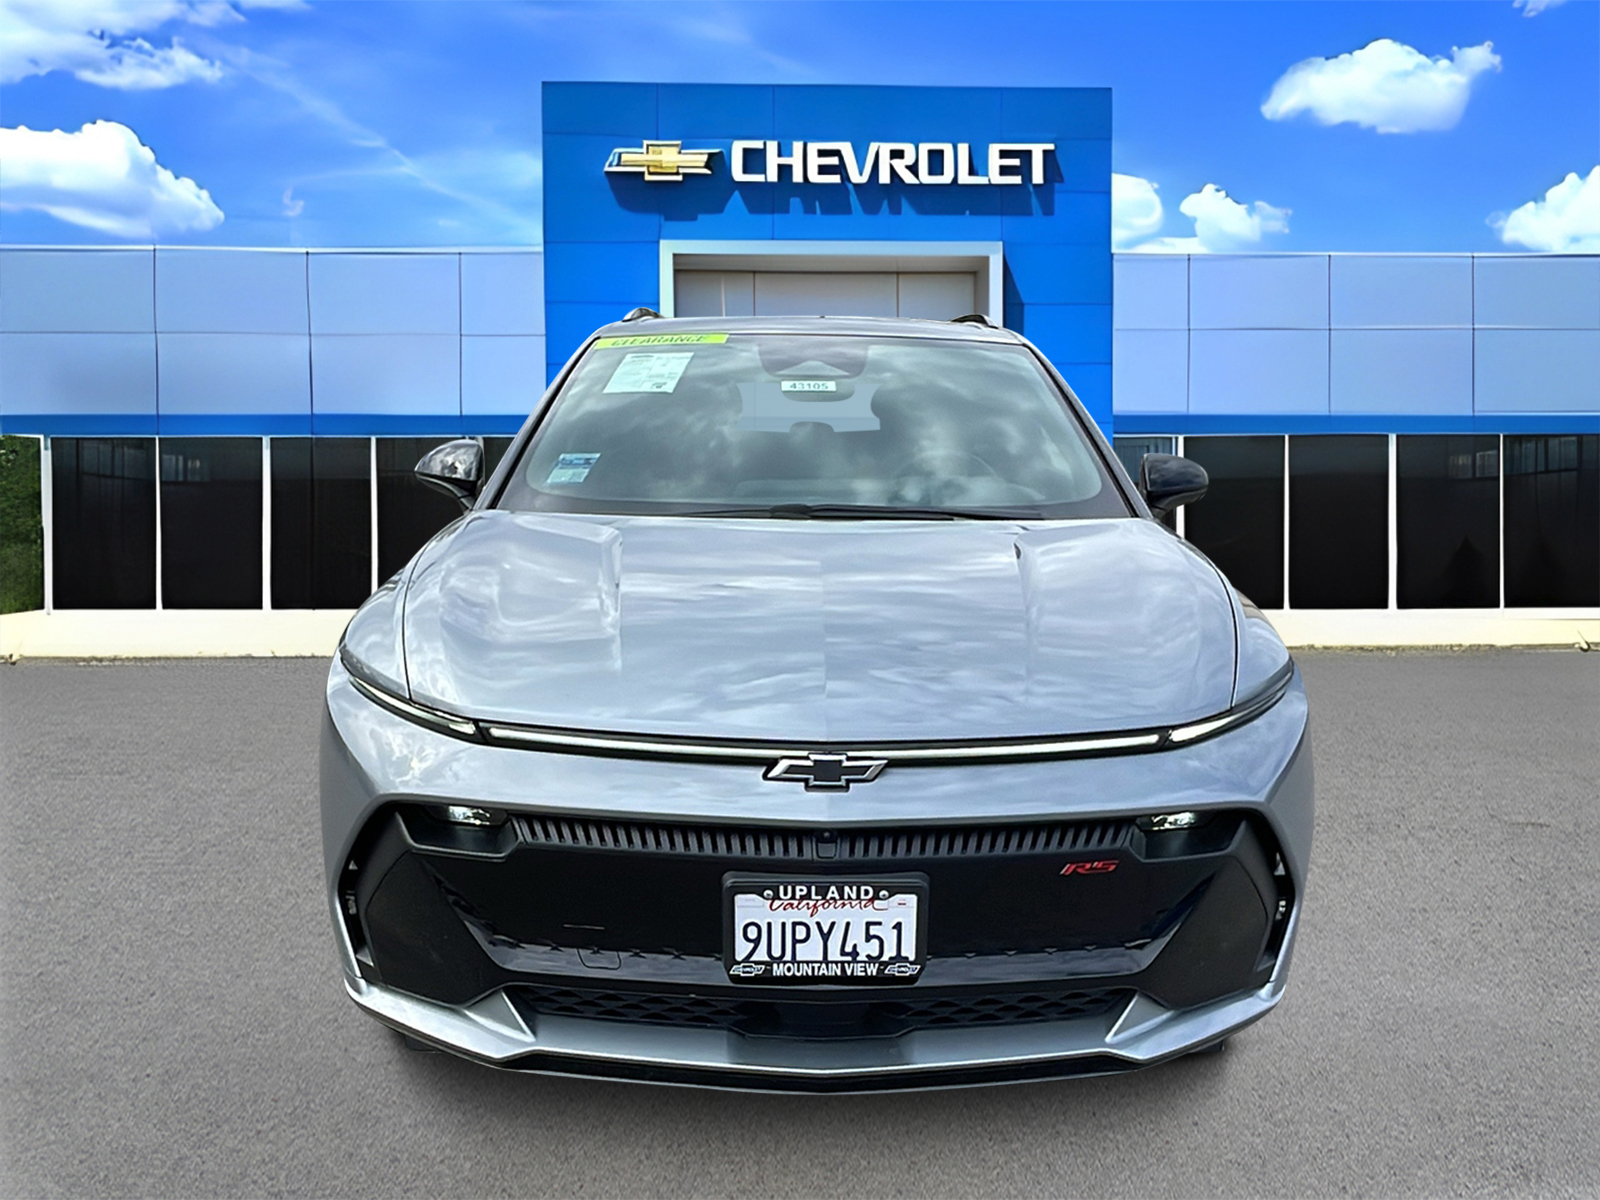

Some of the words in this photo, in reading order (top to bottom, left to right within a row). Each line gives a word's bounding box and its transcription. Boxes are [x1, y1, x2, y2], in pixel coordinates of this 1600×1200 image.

[731, 140, 1055, 185] CHEVROLET
[611, 335, 706, 347] CLEARANCE
[1059, 860, 1119, 876] RS
[779, 885, 874, 900] UPLAND
[742, 921, 910, 961] 9UPY451
[772, 963, 842, 976] MOUNTAIN
[844, 963, 879, 976] VIEW
